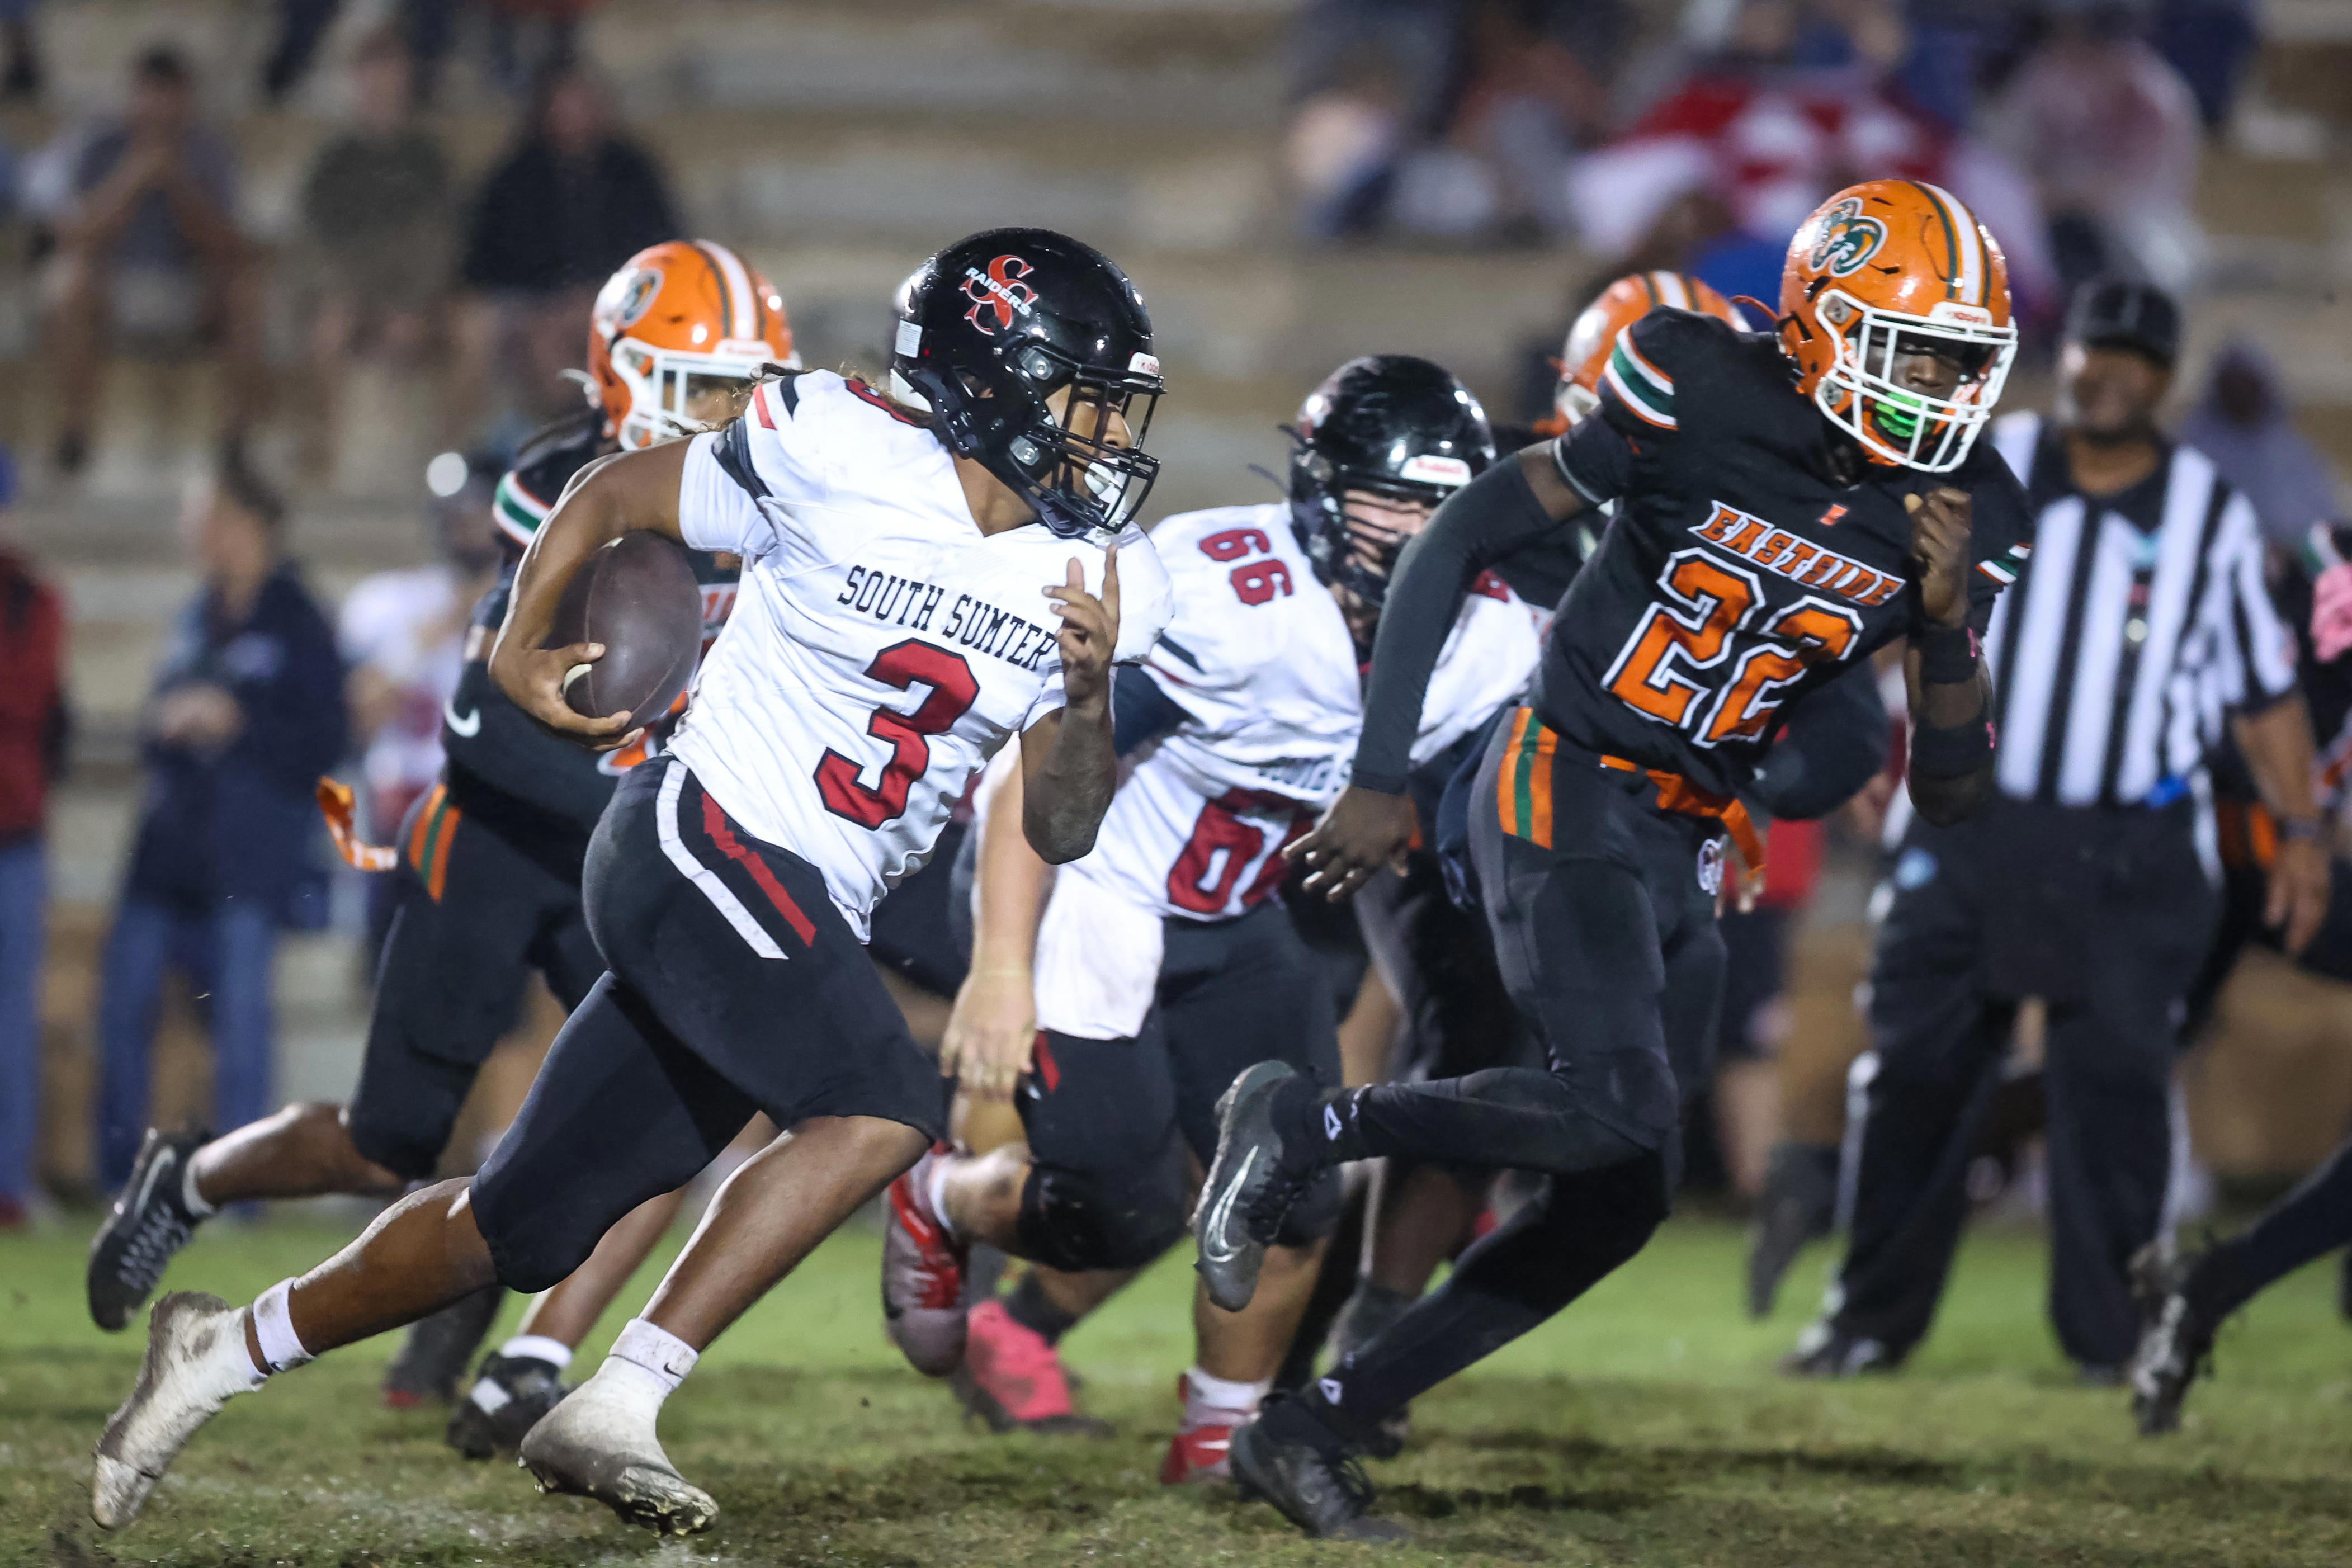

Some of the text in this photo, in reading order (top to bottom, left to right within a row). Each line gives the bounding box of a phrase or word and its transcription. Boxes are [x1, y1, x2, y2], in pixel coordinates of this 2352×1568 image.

[965, 267, 1032, 315] RAIDERS
[1199, 528, 1293, 606] 66
[1688, 500, 1906, 606] EASTSIDE
[837, 565, 1056, 671] SOUTH SUMTER
[1600, 547, 1864, 748] 22
[814, 637, 980, 831] 3
